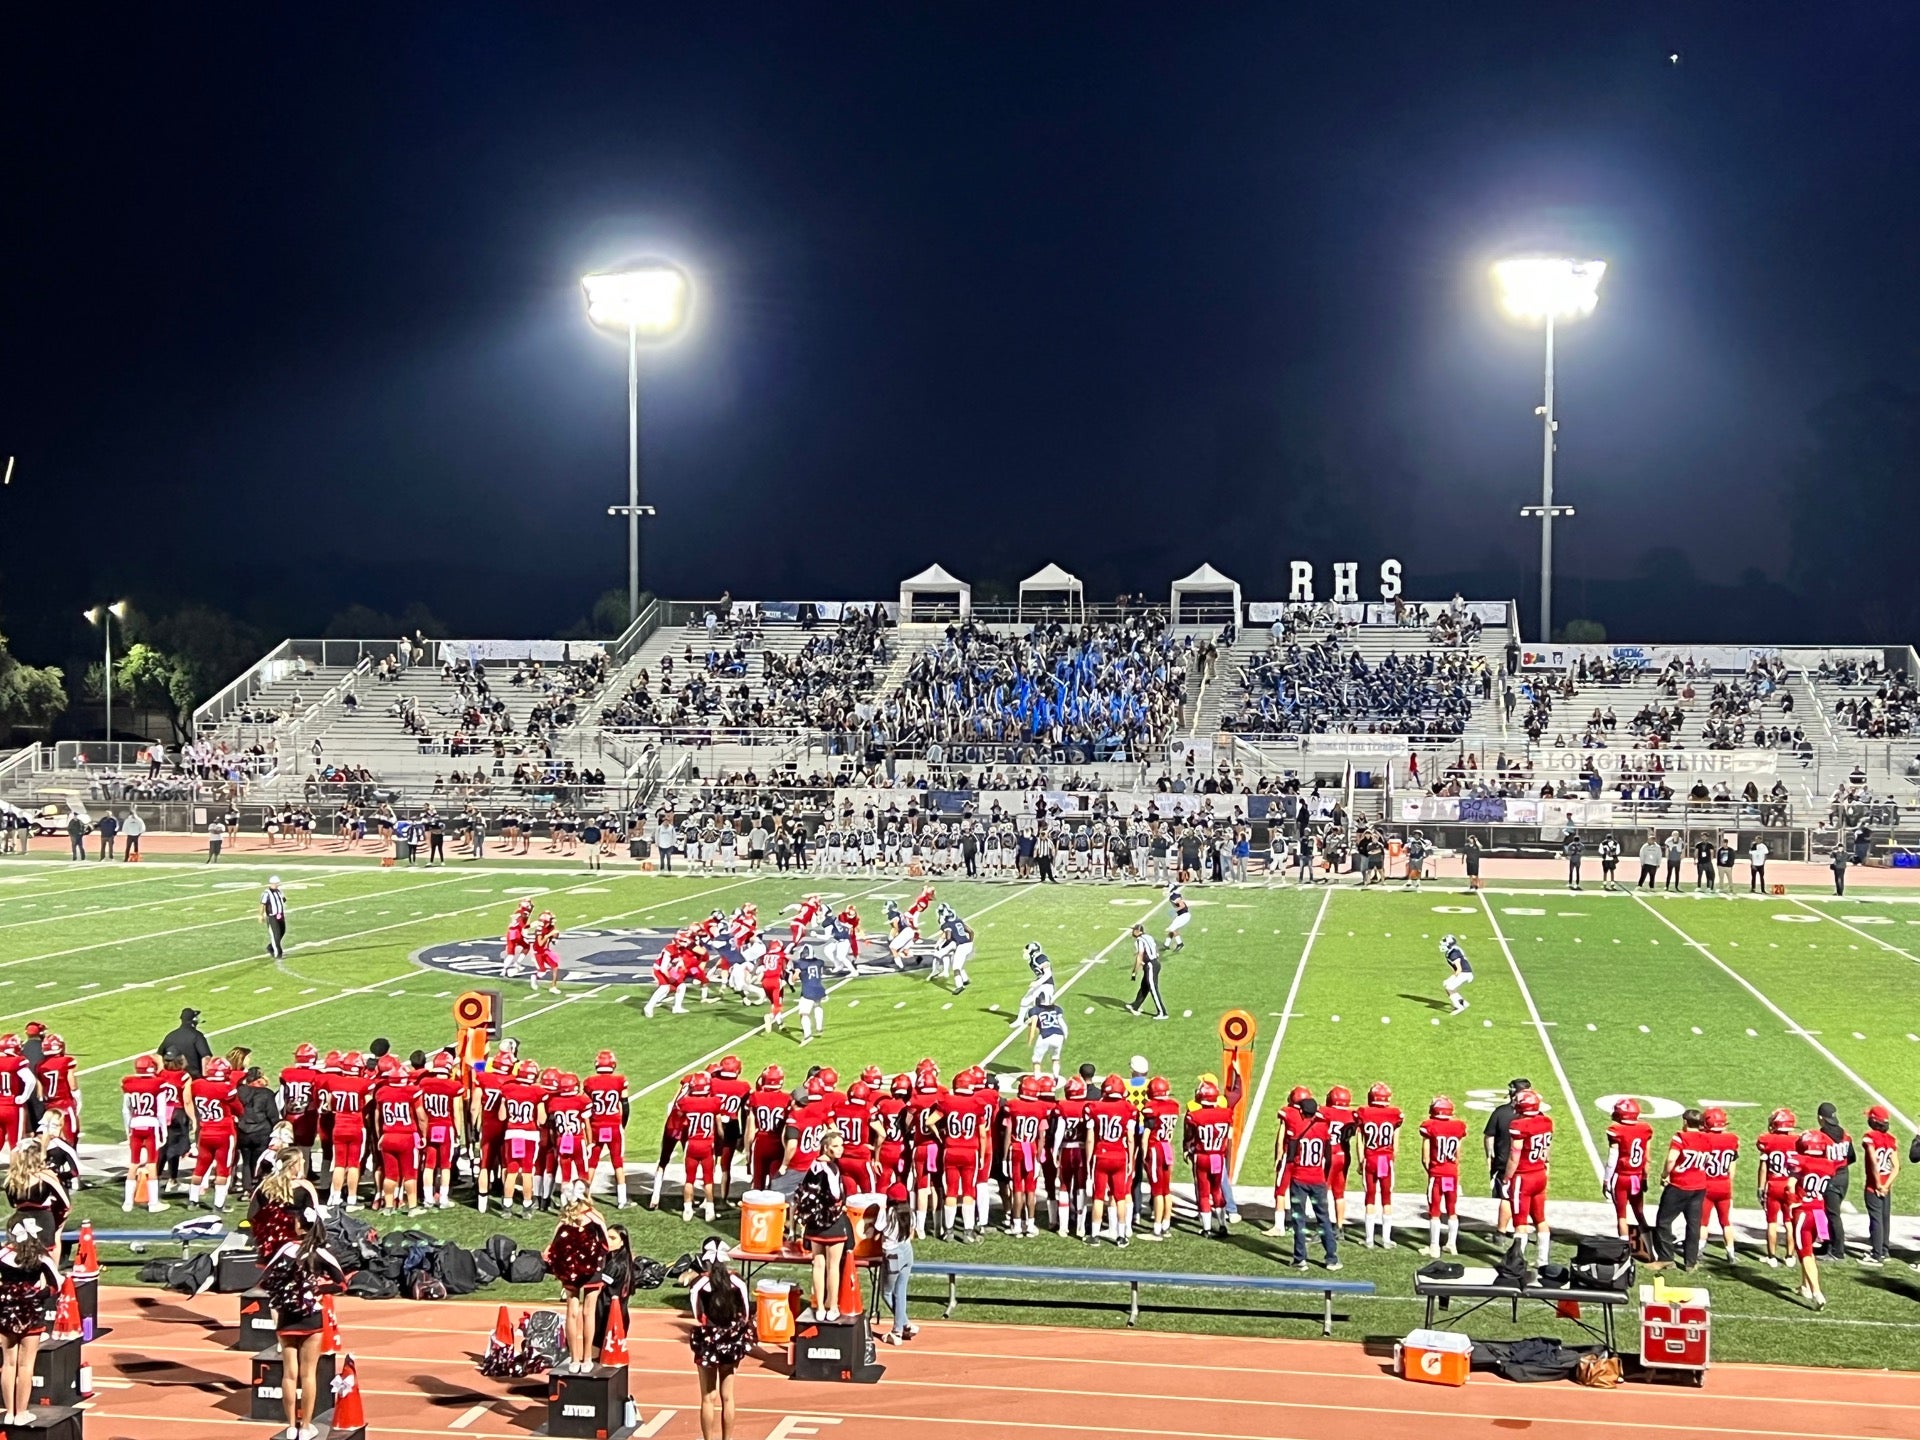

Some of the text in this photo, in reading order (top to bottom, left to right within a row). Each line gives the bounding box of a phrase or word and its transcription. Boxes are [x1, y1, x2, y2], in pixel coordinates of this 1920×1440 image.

[43, 1070, 59, 1097] 7
[332, 1090, 359, 1112] 71
[686, 1112, 714, 1138] 79
[947, 1111, 976, 1139] 69
[1097, 1114, 1123, 1142] 16
[1364, 1122, 1393, 1149] 28
[1300, 1138, 1323, 1166] 18
[1629, 1138, 1643, 1168] 6
